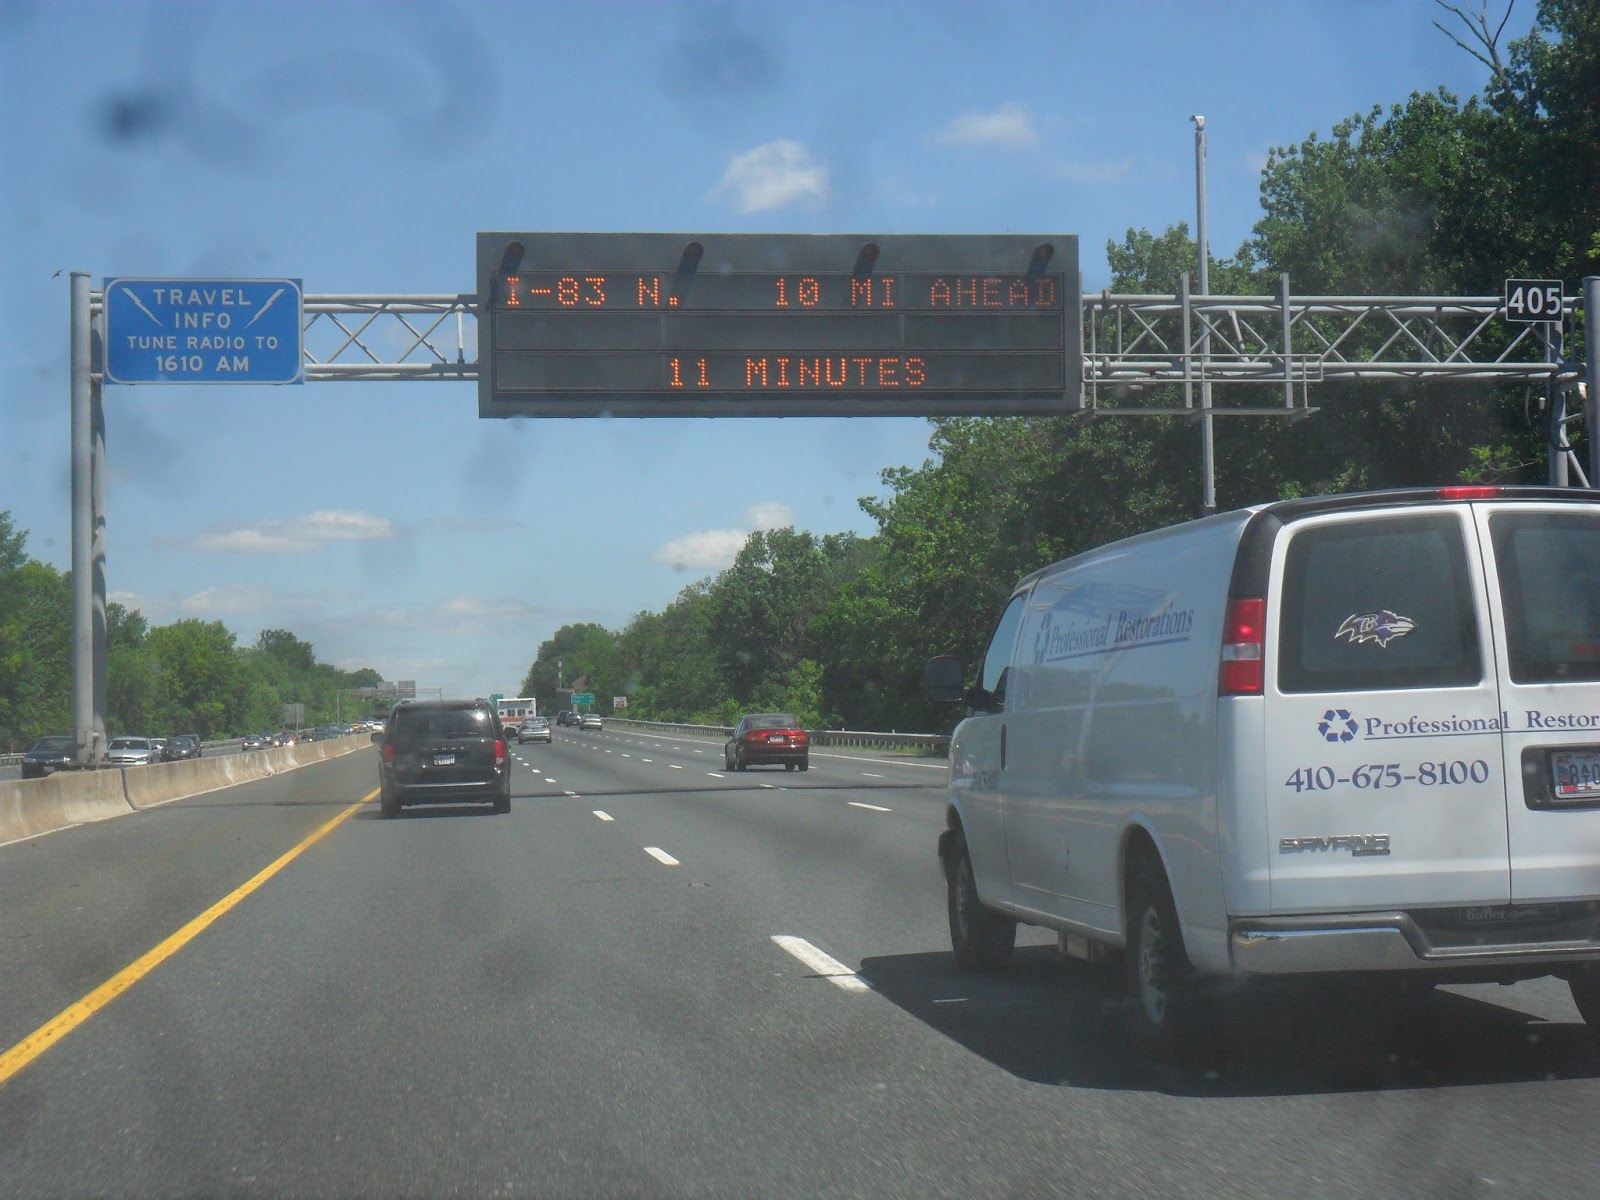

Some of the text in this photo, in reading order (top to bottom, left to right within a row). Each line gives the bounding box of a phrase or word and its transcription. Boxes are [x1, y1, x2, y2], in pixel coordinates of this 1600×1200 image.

[153, 288, 252, 306] TRAVEL
[507, 277, 1055, 306] I-83 N. 10 MI AHEAD
[1508, 286, 1561, 315] 405
[175, 312, 232, 329] INFO
[127, 335, 278, 350] TUNE RADIO TO
[156, 355, 249, 371] 1610 AM
[670, 357, 926, 387] 11 MINUTES
[1049, 602, 1195, 655] Professional Restorations
[1364, 710, 1600, 735] Professional Restor
[1284, 759, 1489, 793] 410-675-8100
[1280, 834, 1390, 852] SAVANA
